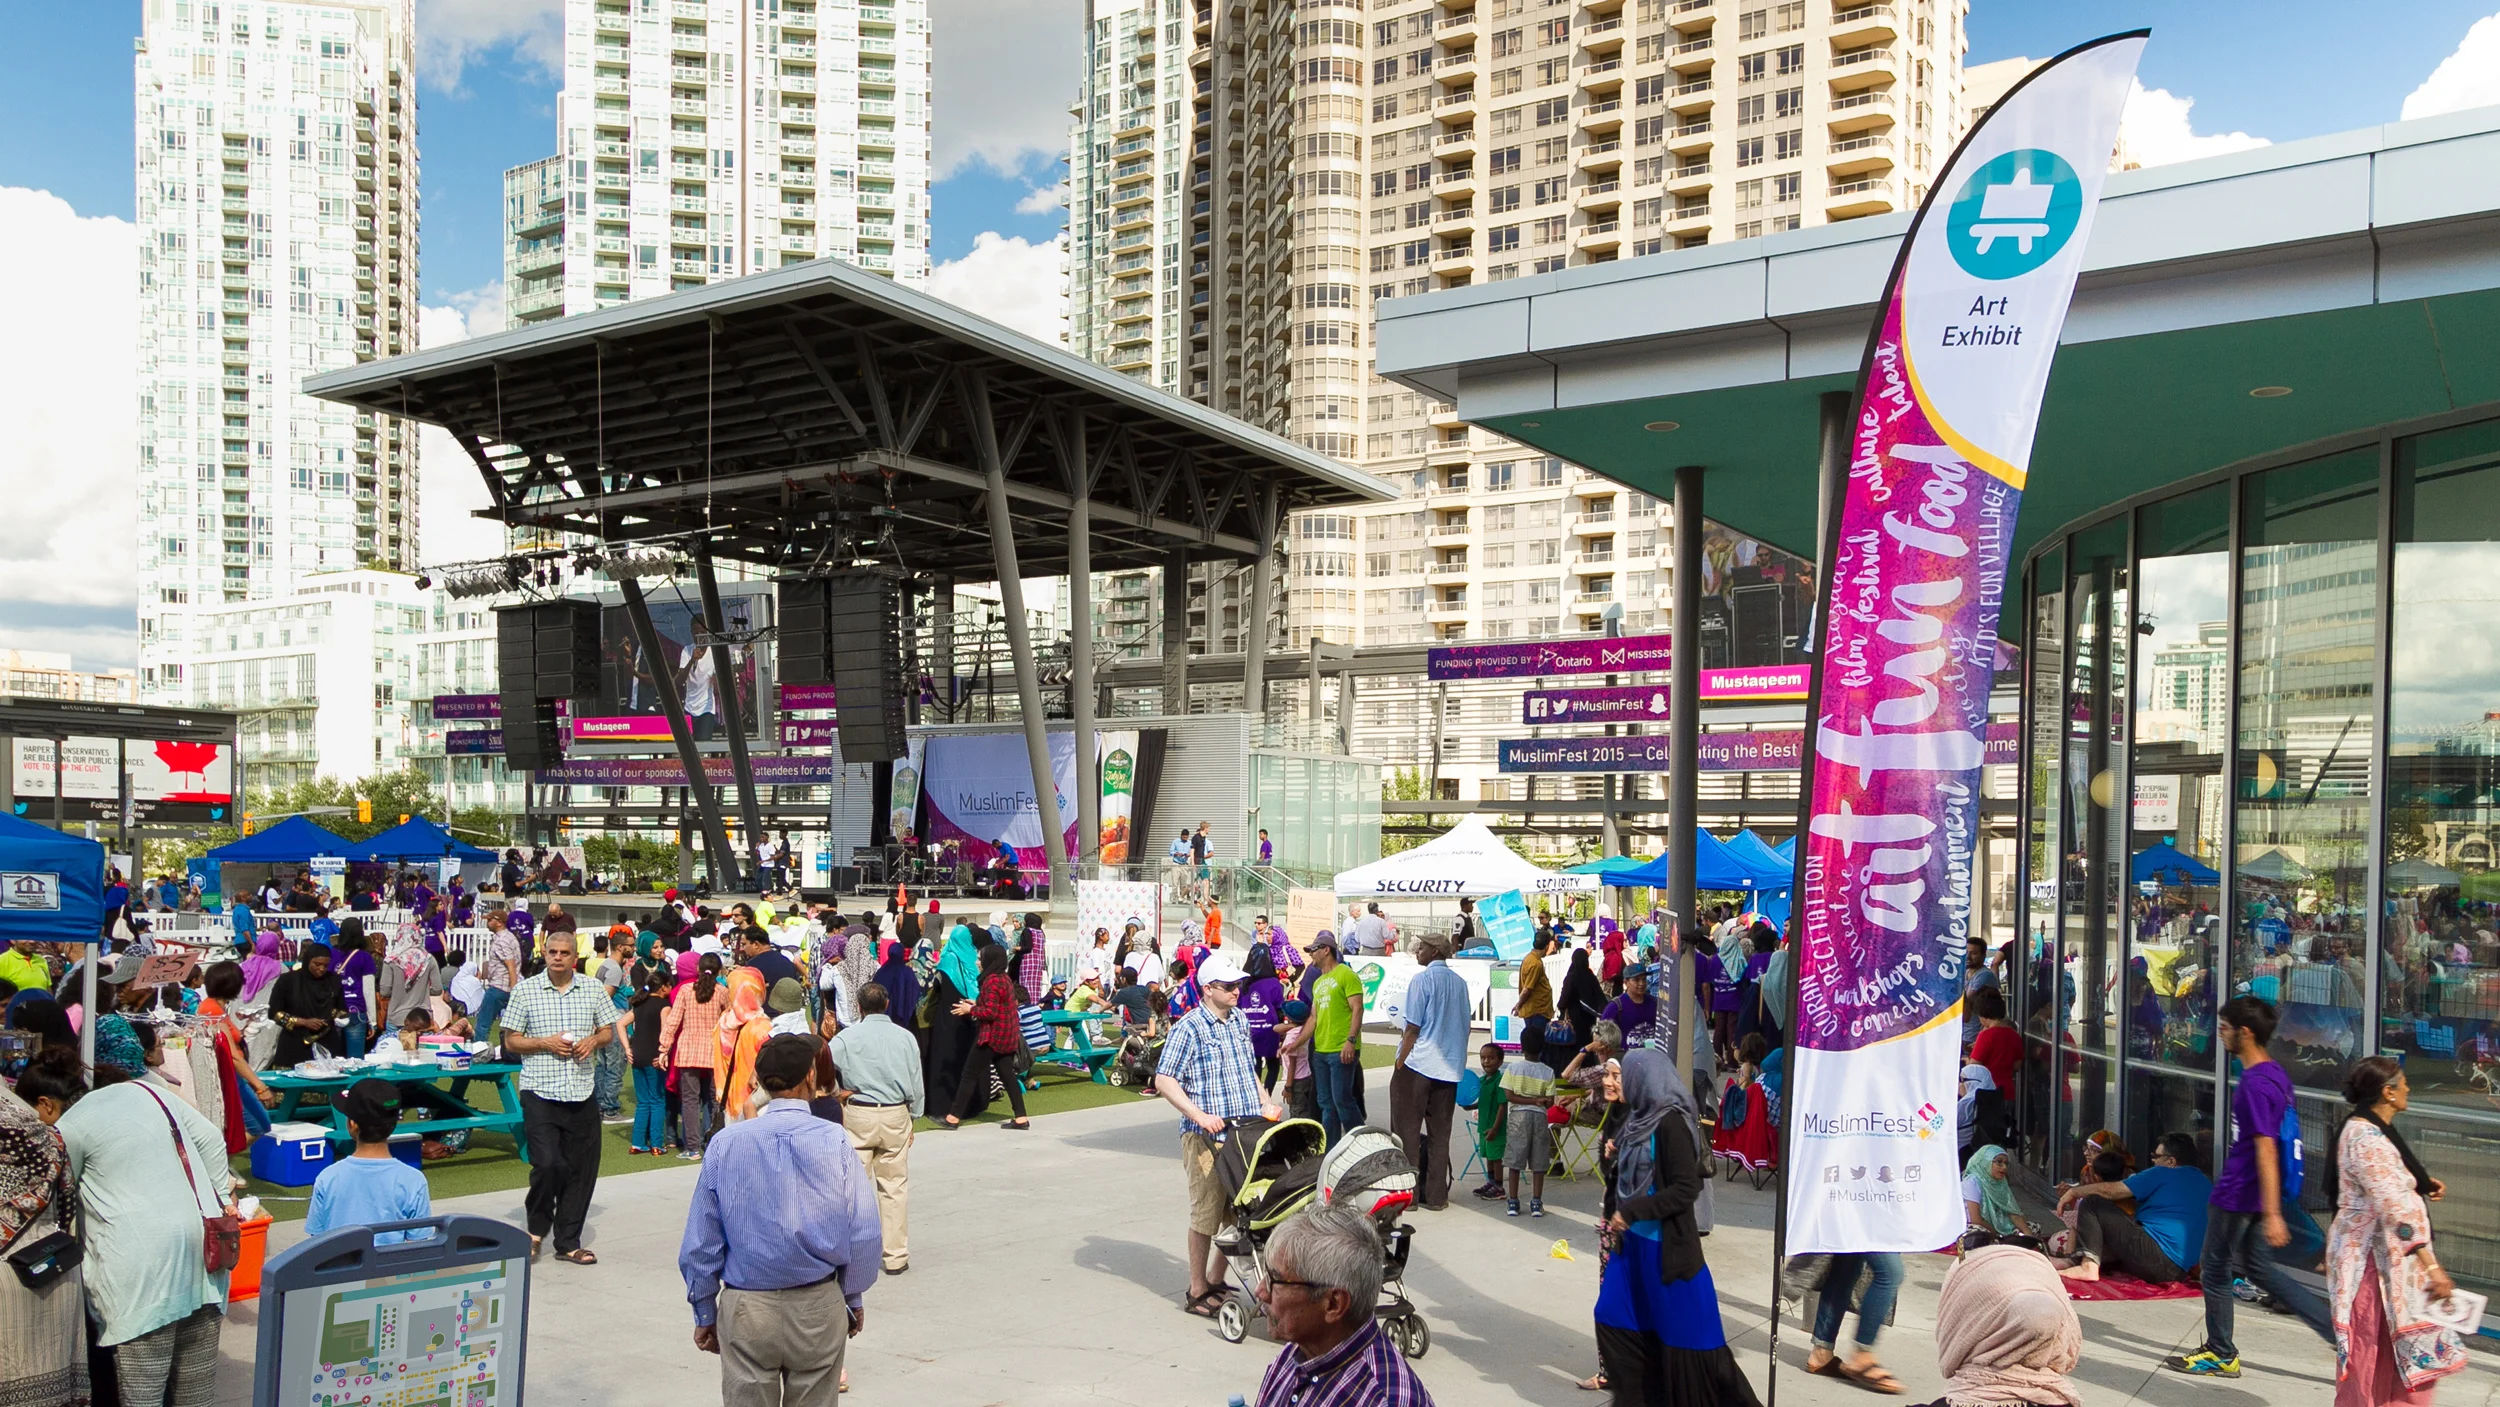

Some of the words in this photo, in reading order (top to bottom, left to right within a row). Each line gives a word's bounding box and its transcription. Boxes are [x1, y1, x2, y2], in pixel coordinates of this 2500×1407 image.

[1968, 295, 2009, 316] Art
[1941, 325, 2023, 347] Exhibit
[1874, 341, 1913, 424] talent
[1849, 406, 1892, 502] culture
[1882, 444, 1970, 558] food
[1978, 481, 2008, 567] VILLAGE
[1846, 529, 1880, 623] festival
[1979, 571, 2003, 609] FUN
[1825, 544, 1854, 656] bazaar
[1968, 612, 2000, 669] KID'S
[1435, 659, 1473, 669] FUNDING
[1475, 656, 1518, 667] PROVIDED
[1520, 656, 1532, 665] BY
[1555, 656, 1593, 668] Ontario
[1834, 632, 1874, 688] film
[1711, 674, 1802, 689] Mustaqeem
[1816, 576, 1985, 790] fun
[1943, 628, 1987, 729] poetry
[437, 703, 475, 711] PRESENTED
[1572, 699, 1644, 712] #MuslimFest
[583, 722, 630, 732] Mustaqeem
[23, 745, 56, 754] HARPER'S
[62, 747, 109, 757] ONSERVATIVES
[38, 754, 71, 763] BLEENG
[72, 756, 87, 764] OUR
[88, 756, 112, 765] PUBLIC
[114, 758, 145, 767] SVICES.
[1509, 748, 1588, 763] MuslimFest
[1592, 747, 1625, 761] 2015
[1646, 744, 1730, 762] Celting
[1734, 744, 1758, 758] the
[1762, 742, 1797, 757] Best
[23, 762, 39, 770] VOTE
[42, 763, 50, 771] TO
[52, 763, 69, 772] SOP
[71, 764, 82, 772] THE
[84, 765, 102, 773] CUTS.
[584, 768, 594, 777] to
[597, 767, 609, 777] all
[612, 767, 623, 777] of
[625, 769, 642, 778] our
[645, 769, 686, 780] sponsors,
[704, 768, 735, 778] nteers,
[755, 766, 798, 776] attendees
[801, 764, 814, 775] for
[90, 801, 113, 809] Follow
[1809, 799, 1937, 933] art
[1936, 780, 1970, 981] entertainment
[1376, 879, 1466, 892] SECURITY
[1805, 855, 1843, 988] RECITATION
[1828, 862, 1865, 968] theatre
[141, 972, 184, 983] EACH
[152, 955, 190, 973] $5
[1834, 952, 1924, 1007] workshops
[1798, 974, 1838, 1038] QURAN
[1850, 988, 1935, 1038] comedy
[1803, 1111, 1915, 1134] MuslimFest
[1828, 1189, 1916, 1203] #MuslimFest
